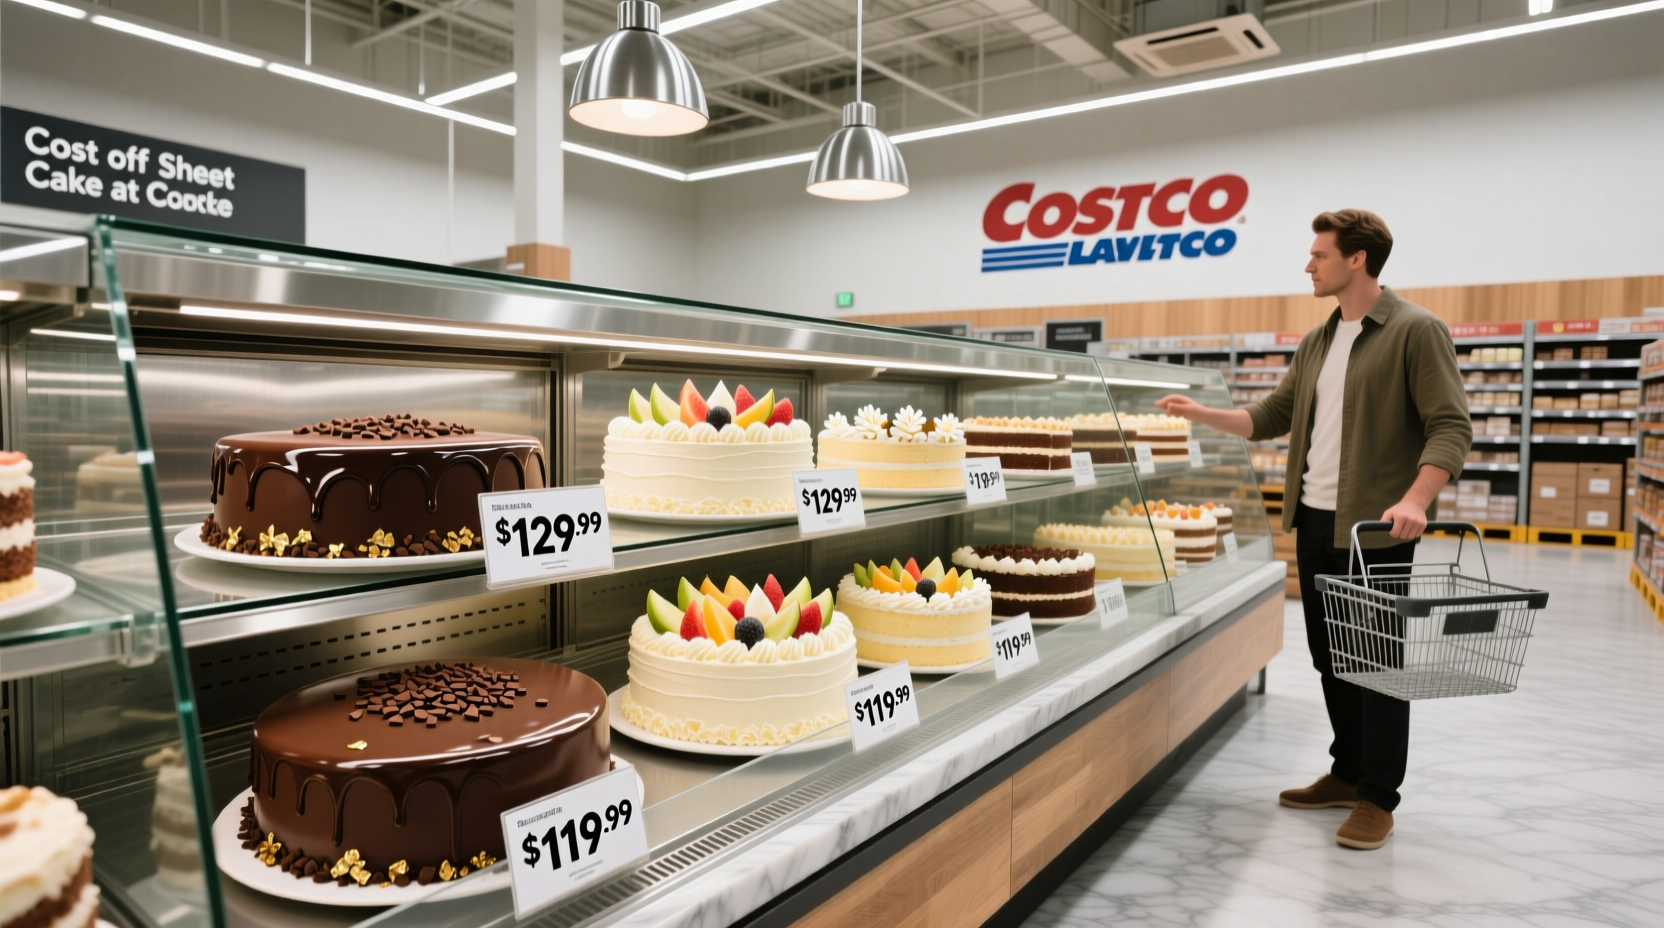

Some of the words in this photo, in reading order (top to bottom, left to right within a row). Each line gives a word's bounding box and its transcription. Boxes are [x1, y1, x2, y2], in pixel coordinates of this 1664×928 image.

[24, 126, 99, 165] Cost
[107, 145, 150, 174] off
[158, 152, 235, 190] Sheet
[25, 160, 103, 198] Cake
[110, 179, 140, 204] at
[982, 173, 1249, 243] COSTCO
[495, 511, 602, 557] $129.99
[854, 684, 910, 727] $119.99
[521, 798, 633, 871] $119.99
